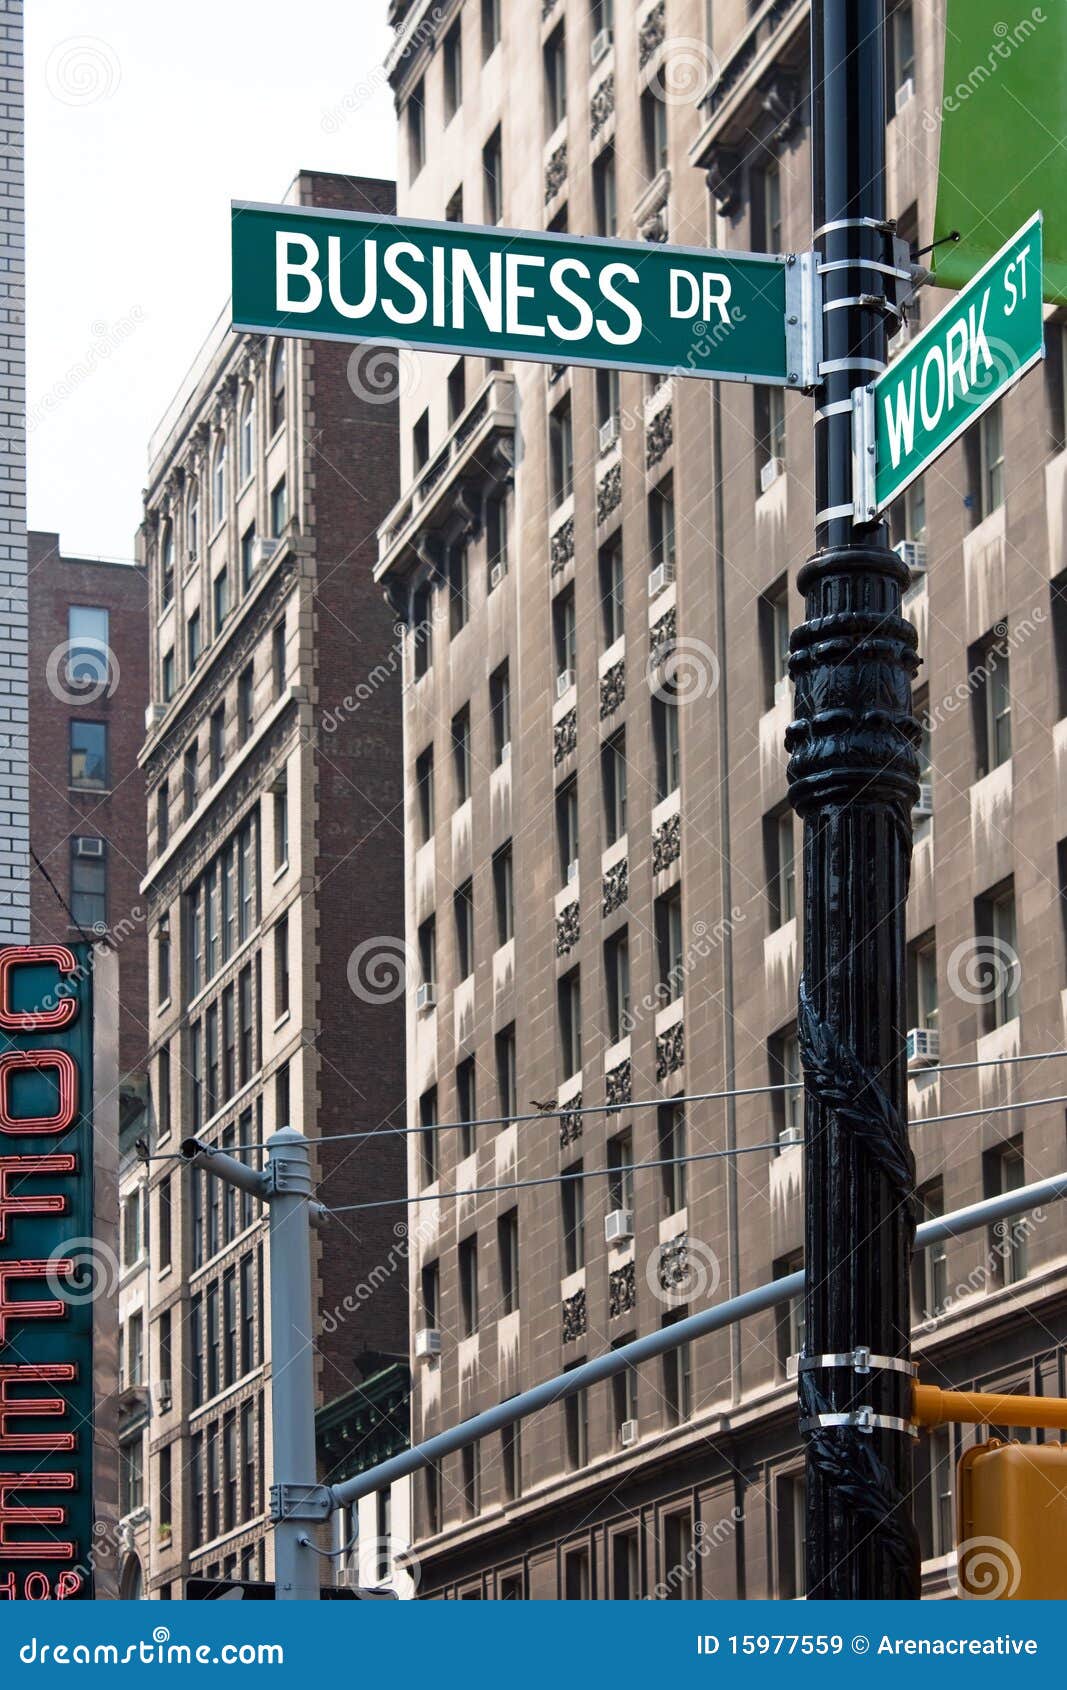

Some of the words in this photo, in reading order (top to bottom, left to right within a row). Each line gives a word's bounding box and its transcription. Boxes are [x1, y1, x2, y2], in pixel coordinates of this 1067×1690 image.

[275, 230, 643, 346] BUSINESS
[669, 269, 733, 324] DR
[884, 287, 994, 470] WORK
[1003, 245, 1031, 317] ST
[0, 944, 77, 1559] COFFEE
